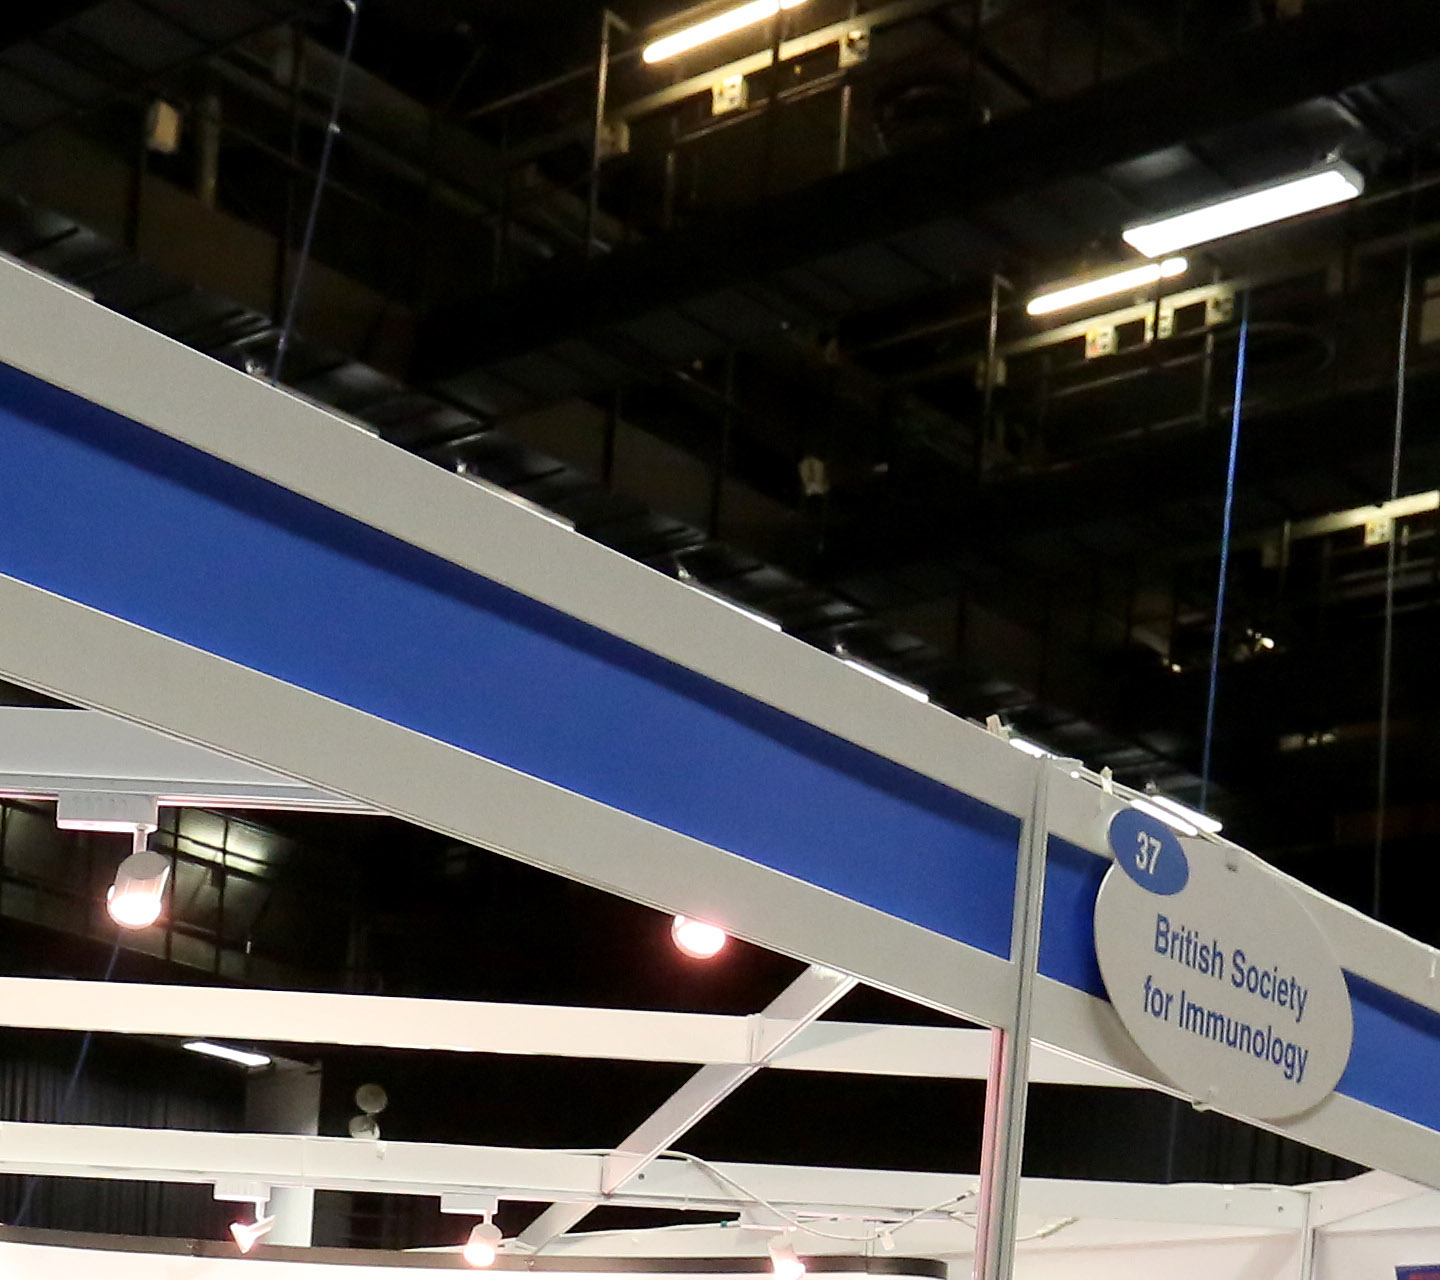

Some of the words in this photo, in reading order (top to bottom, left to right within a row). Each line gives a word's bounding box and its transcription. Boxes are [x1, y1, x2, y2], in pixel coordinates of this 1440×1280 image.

[1135, 831, 1162, 874] 37
[1155, 913, 1224, 980] British
[1231, 949, 1308, 1023] Society
[1144, 975, 1173, 1021] for
[1179, 990, 1308, 1084] Immunology
